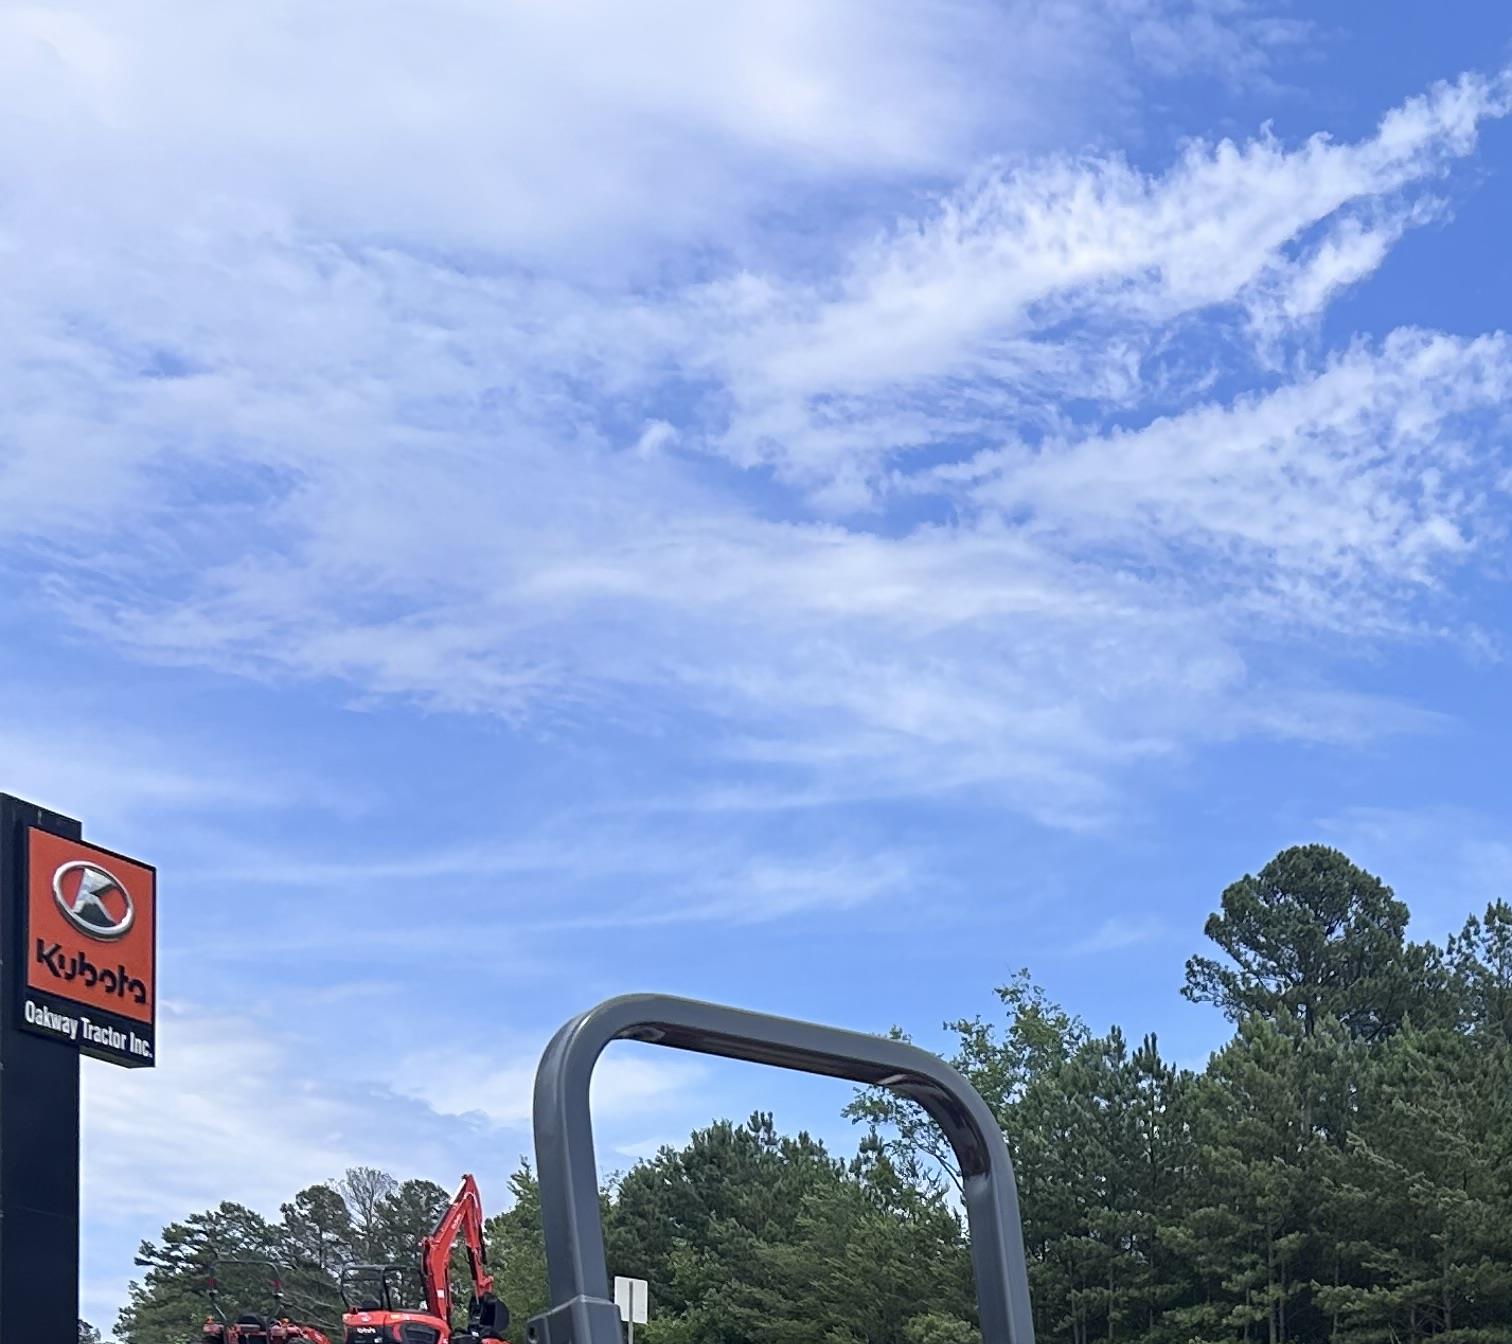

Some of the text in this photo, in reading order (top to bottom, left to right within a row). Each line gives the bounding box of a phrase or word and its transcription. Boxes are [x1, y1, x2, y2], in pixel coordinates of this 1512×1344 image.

[36, 938, 148, 1004] Kubota
[24, 1000, 153, 1058] Oakway Tractor Inc.
